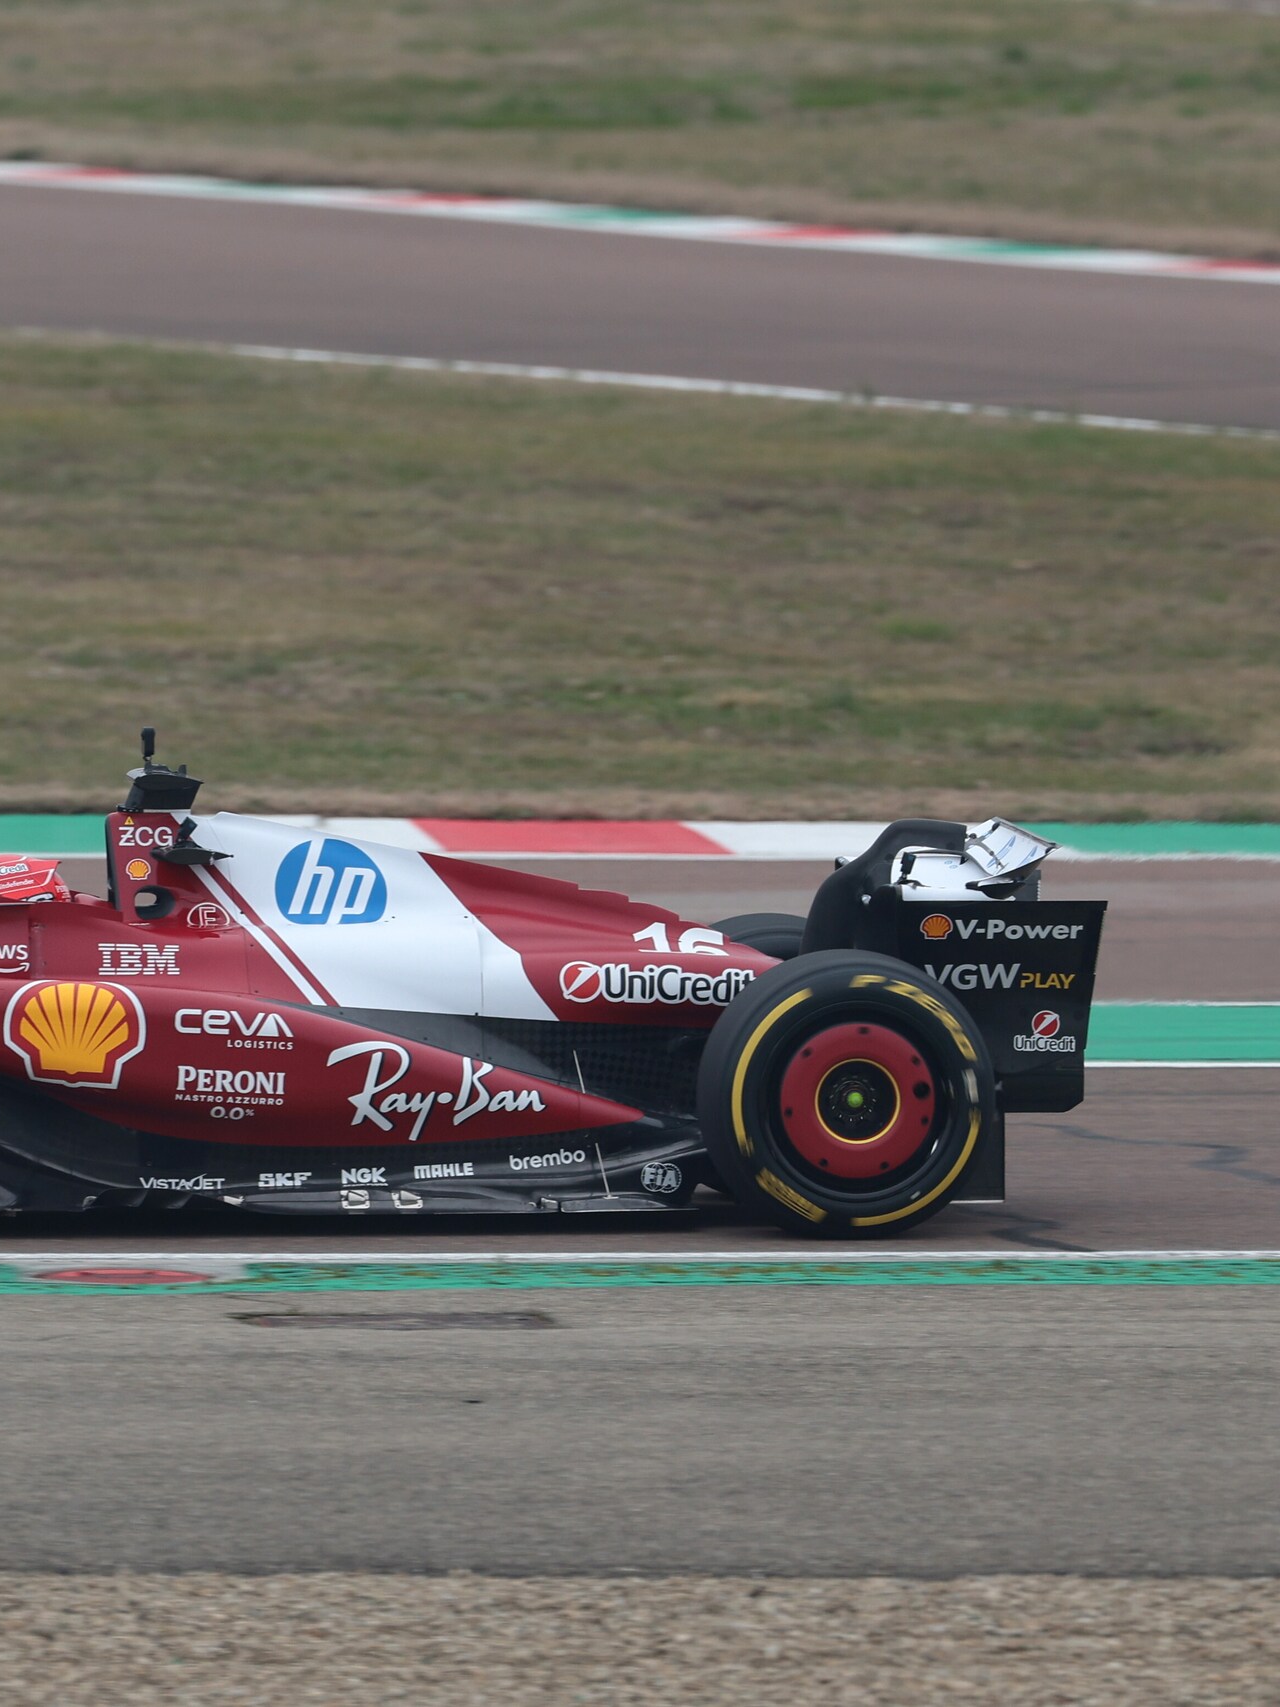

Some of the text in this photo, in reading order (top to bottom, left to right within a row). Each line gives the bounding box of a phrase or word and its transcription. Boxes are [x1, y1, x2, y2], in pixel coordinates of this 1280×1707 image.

[286, 838, 377, 925] hp
[955, 919, 1083, 940] V-Power
[99, 943, 181, 976] IBM
[924, 963, 1076, 990] VGW PLAY
[227, 1039, 294, 1050] LOGISTICS
[1014, 1034, 1076, 1052] UniCredit
[176, 1065, 286, 1095] PERONI
[175, 1093, 284, 1106] NASTRO AZZURRO
[210, 1106, 255, 1120] 0.0%
[509, 1149, 586, 1171] brembo
[258, 1172, 312, 1188] SKF
[341, 1167, 388, 1184] NGK
[414, 1162, 474, 1180] MAHLE
